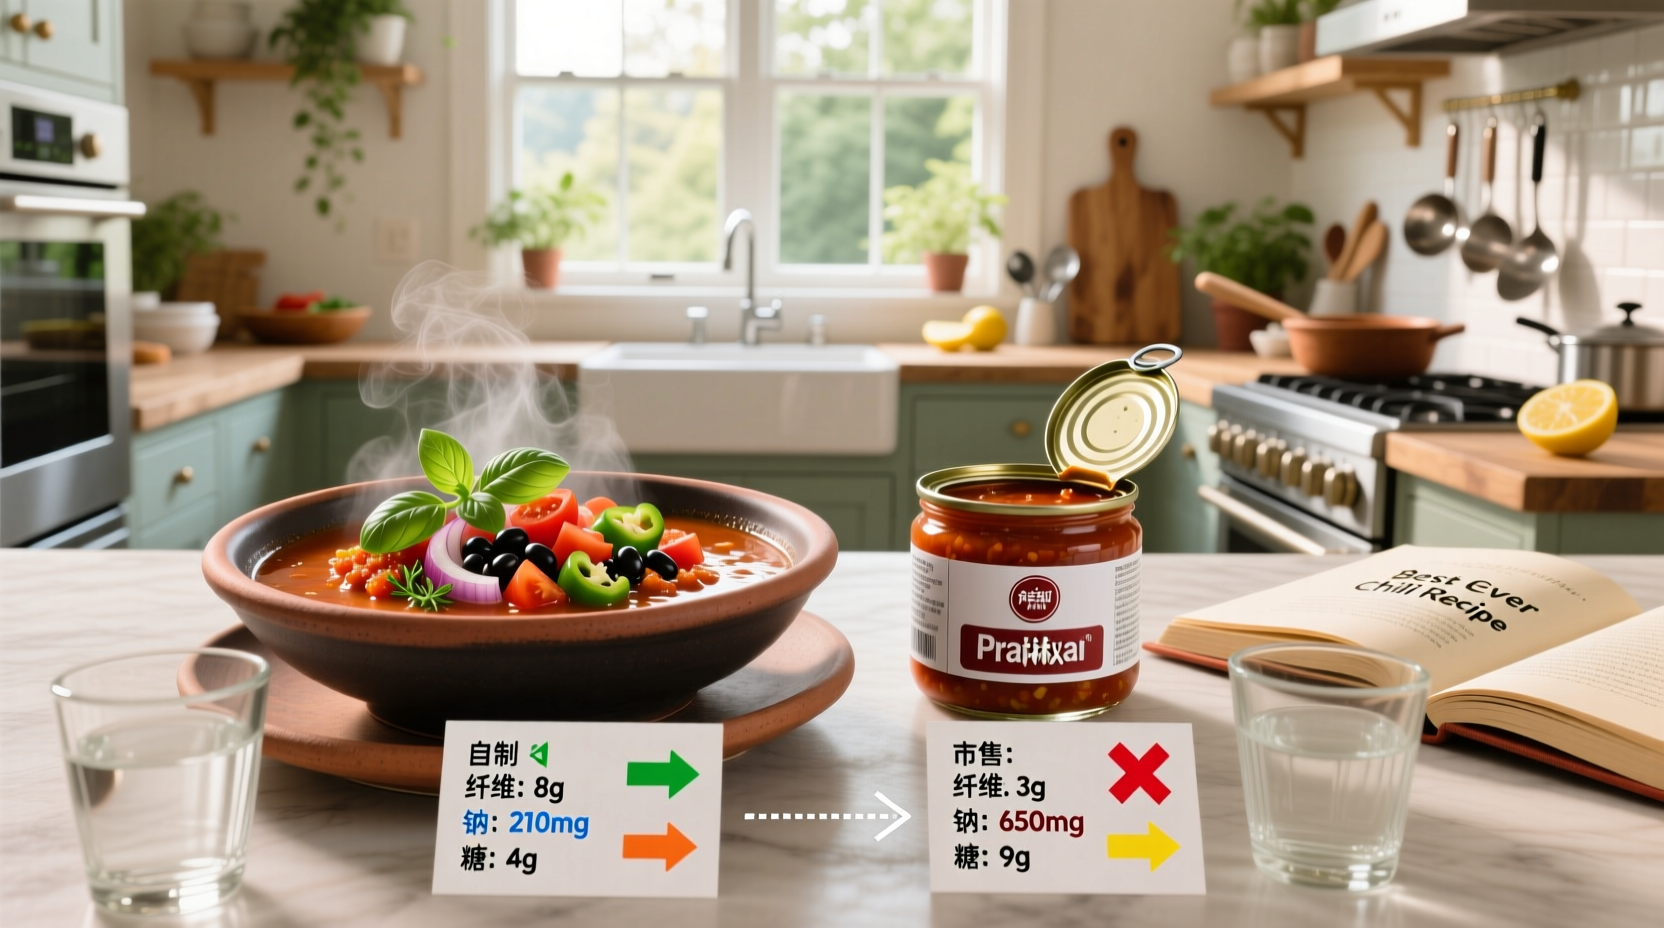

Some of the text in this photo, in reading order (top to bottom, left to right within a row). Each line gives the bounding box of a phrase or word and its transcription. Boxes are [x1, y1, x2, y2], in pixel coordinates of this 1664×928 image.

[1354, 580, 1418, 596] Chili
[1418, 586, 1508, 632] Recipe
[1391, 569, 1461, 586] Best
[1465, 579, 1540, 614] Ever
[469, 740, 519, 768] 自制
[952, 740, 1013, 767] 市售:
[464, 773, 565, 805] 纤维: 8g
[1016, 775, 1046, 803] 3g
[462, 808, 590, 840] 钠: 210mg
[952, 807, 1084, 839] 钠: 650mg
[460, 843, 538, 876] 糖: 4g
[953, 842, 1031, 873] 糖: 9g
